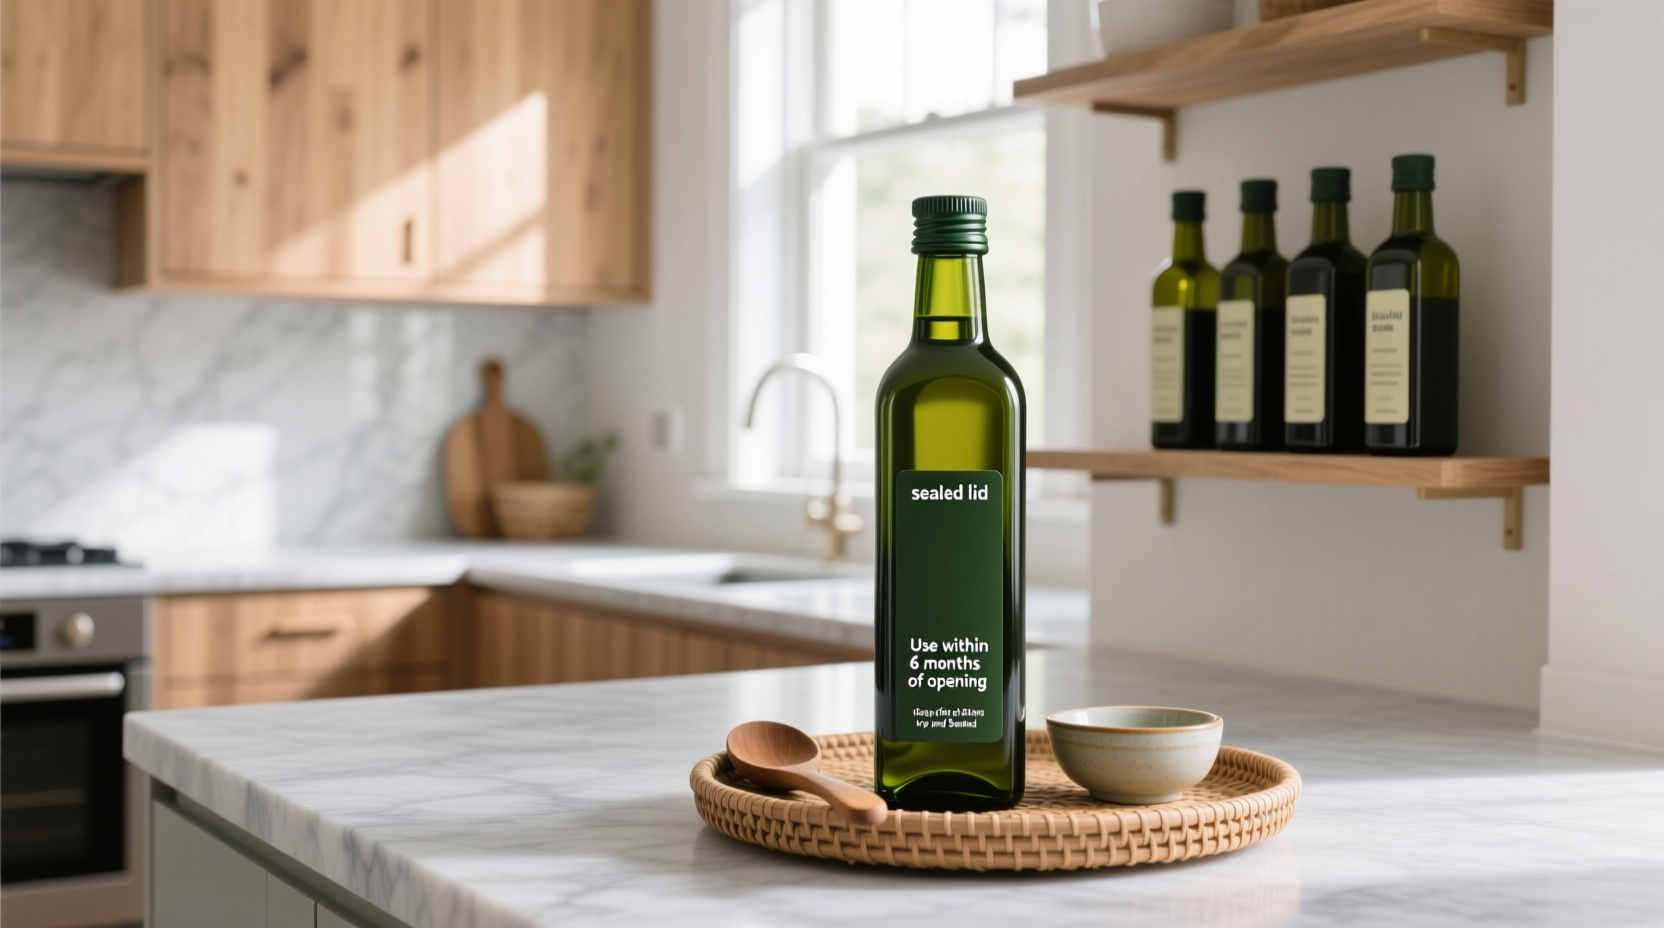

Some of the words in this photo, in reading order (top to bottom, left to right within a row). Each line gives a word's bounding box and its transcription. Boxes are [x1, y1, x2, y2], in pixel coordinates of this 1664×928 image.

[911, 483, 964, 501] sealed
[968, 483, 989, 501] lid
[910, 637, 939, 653] Use
[942, 636, 989, 653] within
[909, 654, 920, 670] 6
[923, 654, 981, 671] months
[907, 672, 925, 688] of
[927, 673, 988, 693] opening
